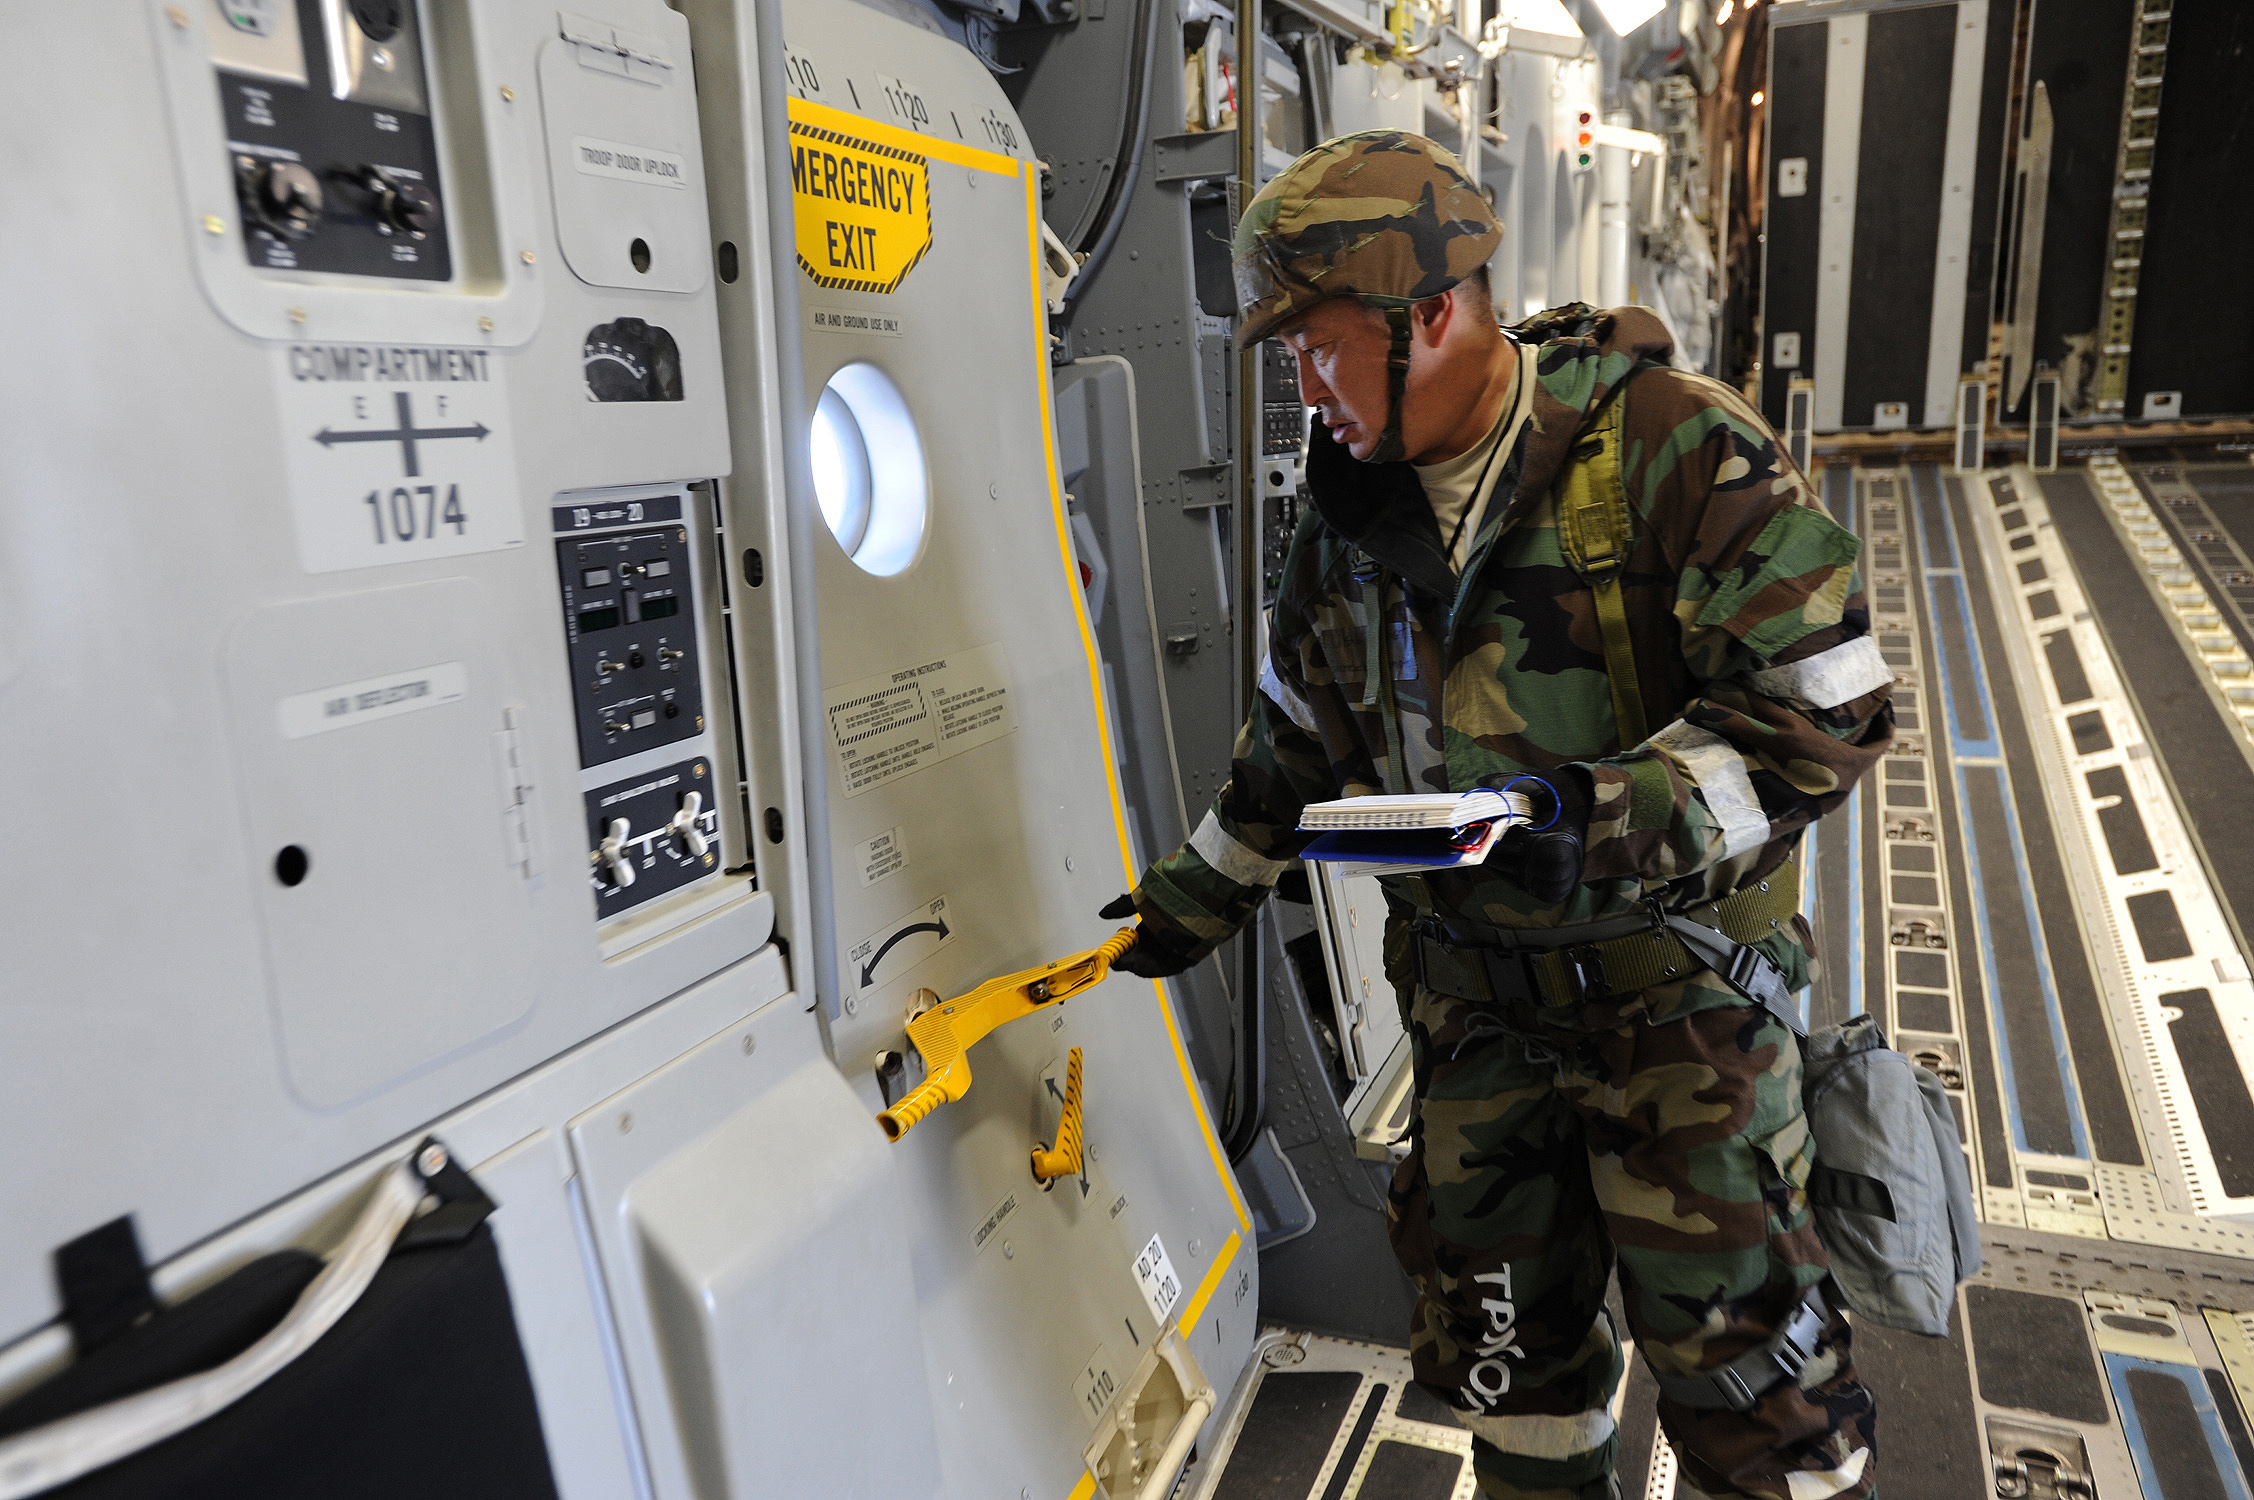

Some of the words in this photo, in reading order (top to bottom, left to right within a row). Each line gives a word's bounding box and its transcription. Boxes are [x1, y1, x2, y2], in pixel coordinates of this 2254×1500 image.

[885, 86, 929, 125] 1120
[981, 116, 1018, 150] 1130
[580, 146, 612, 167] TROOP
[615, 152, 642, 172] DOOR
[643, 157, 680, 179] UPLOCK
[790, 143, 914, 214] MERGENCY
[826, 220, 876, 271] EXIT
[815, 312, 826, 326] AIR
[828, 314, 841, 327] AND
[843, 315, 868, 329] GROUND
[870, 318, 882, 330] USE
[884, 319, 898, 332] ONLY
[289, 346, 490, 382] COMPARTMENT
[352, 395, 368, 420] E
[436, 394, 448, 418] F
[363, 483, 468, 544] 1074
[891, 668, 917, 683] OPERATING
[917, 660, 947, 675] INSTRUCTIONS
[870, 835, 890, 851] CAUTION
[929, 896, 945, 915] OPEN
[851, 940, 873, 962] CLOSE
[1051, 1015, 1065, 1033] LOCK
[974, 1215, 997, 1248] LOCKING
[996, 1194, 1016, 1223] HANDLE
[1109, 1194, 1127, 1220] UNLOCK
[1137, 1256, 1151, 1284] AD
[1148, 1240, 1163, 1267] 20
[1154, 1275, 1177, 1315] 1120
[1235, 1273, 1249, 1308] 1130
[1087, 1369, 1114, 1416] 1110
